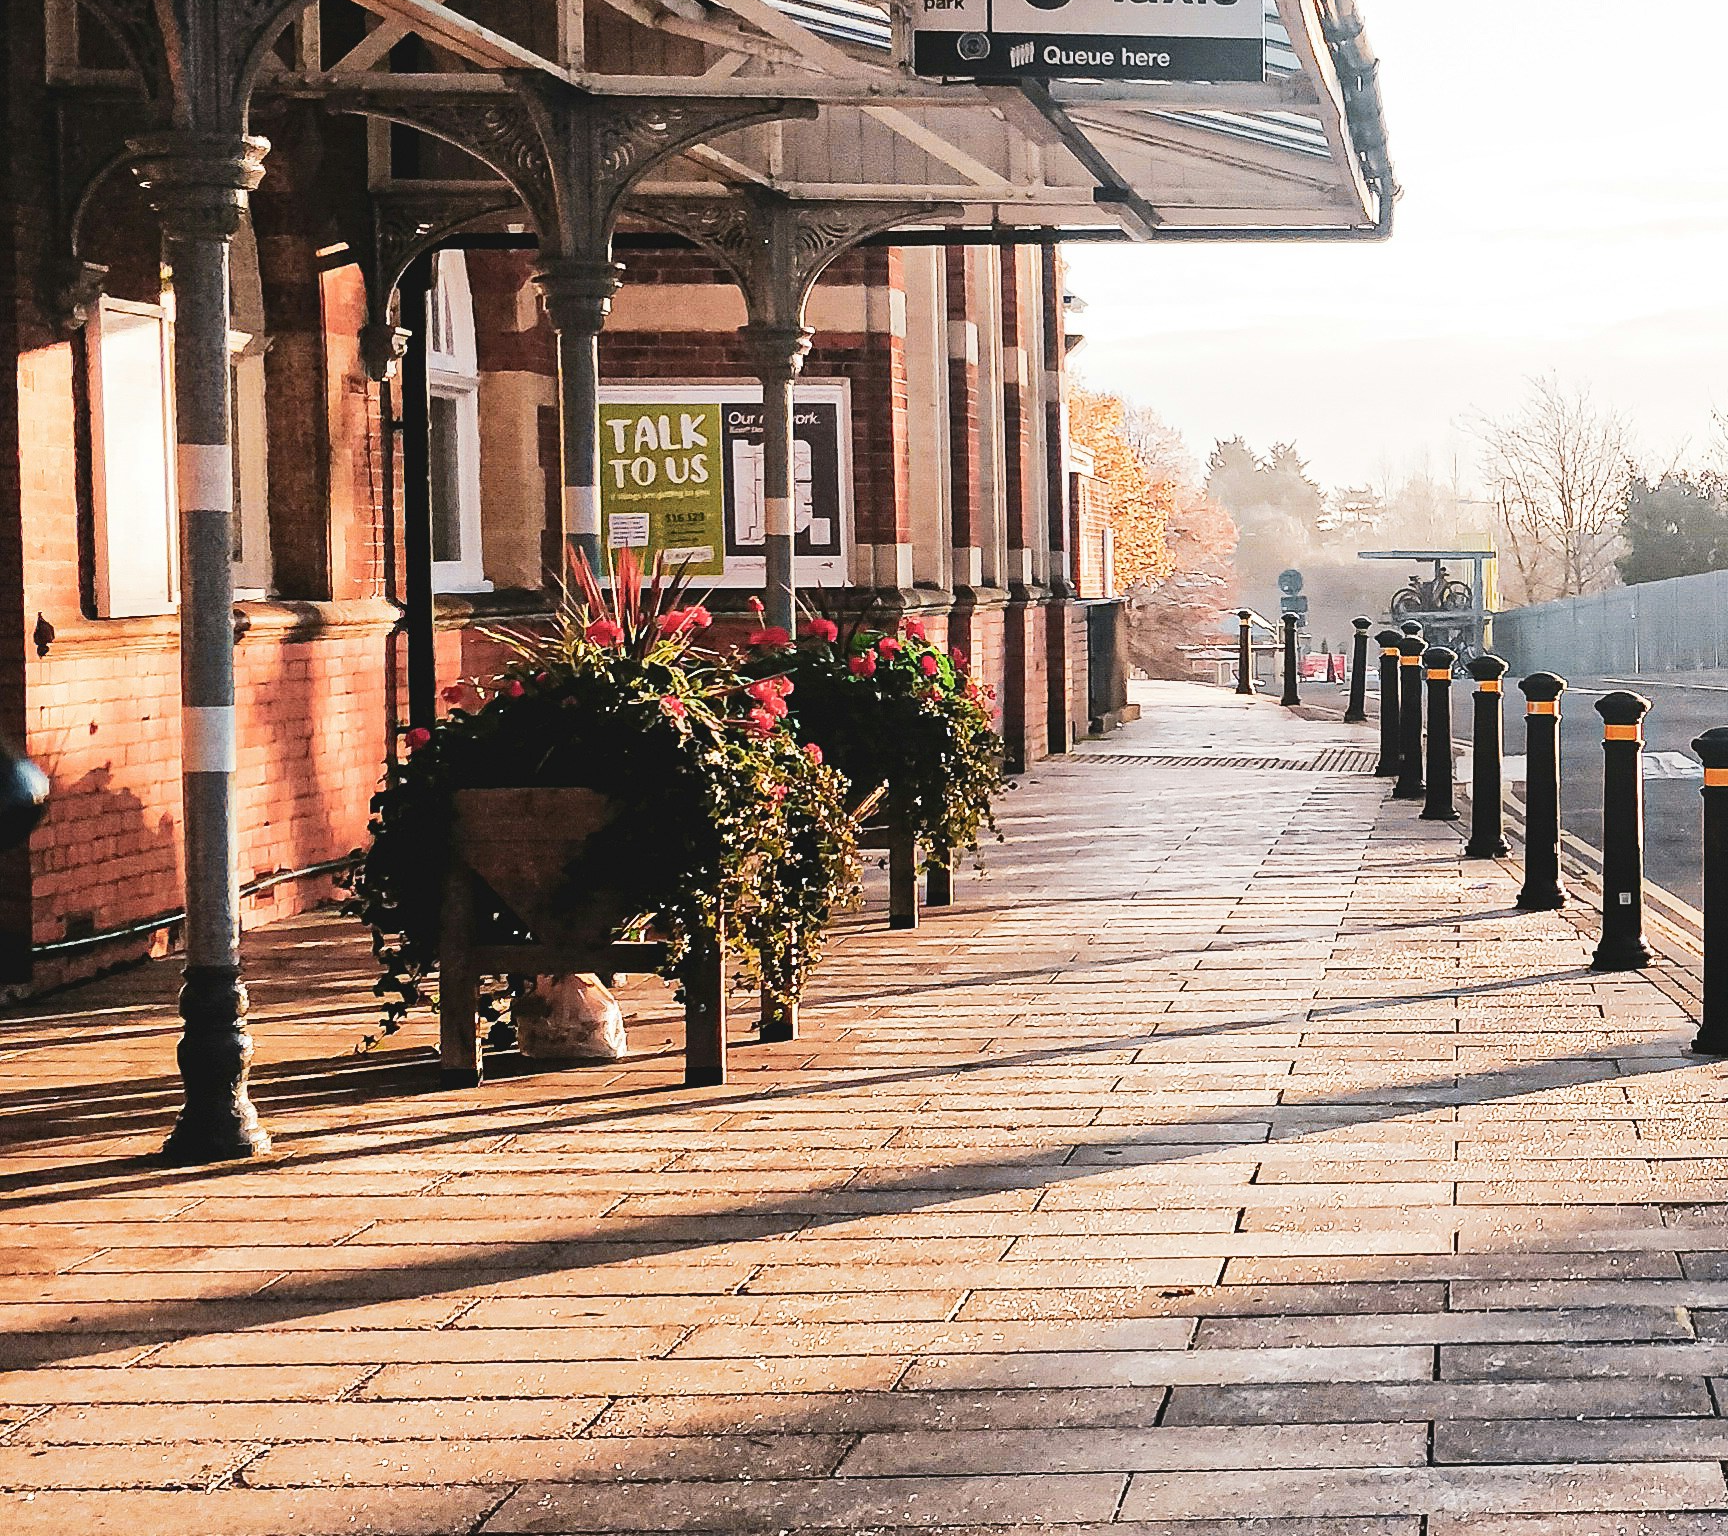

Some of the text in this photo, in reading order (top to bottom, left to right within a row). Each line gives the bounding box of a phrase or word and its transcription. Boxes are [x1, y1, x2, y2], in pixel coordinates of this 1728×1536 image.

[1043, 45, 1171, 67] Queue here
[728, 411, 756, 425] Our
[605, 413, 708, 454] TALK
[608, 453, 709, 489] TO US
